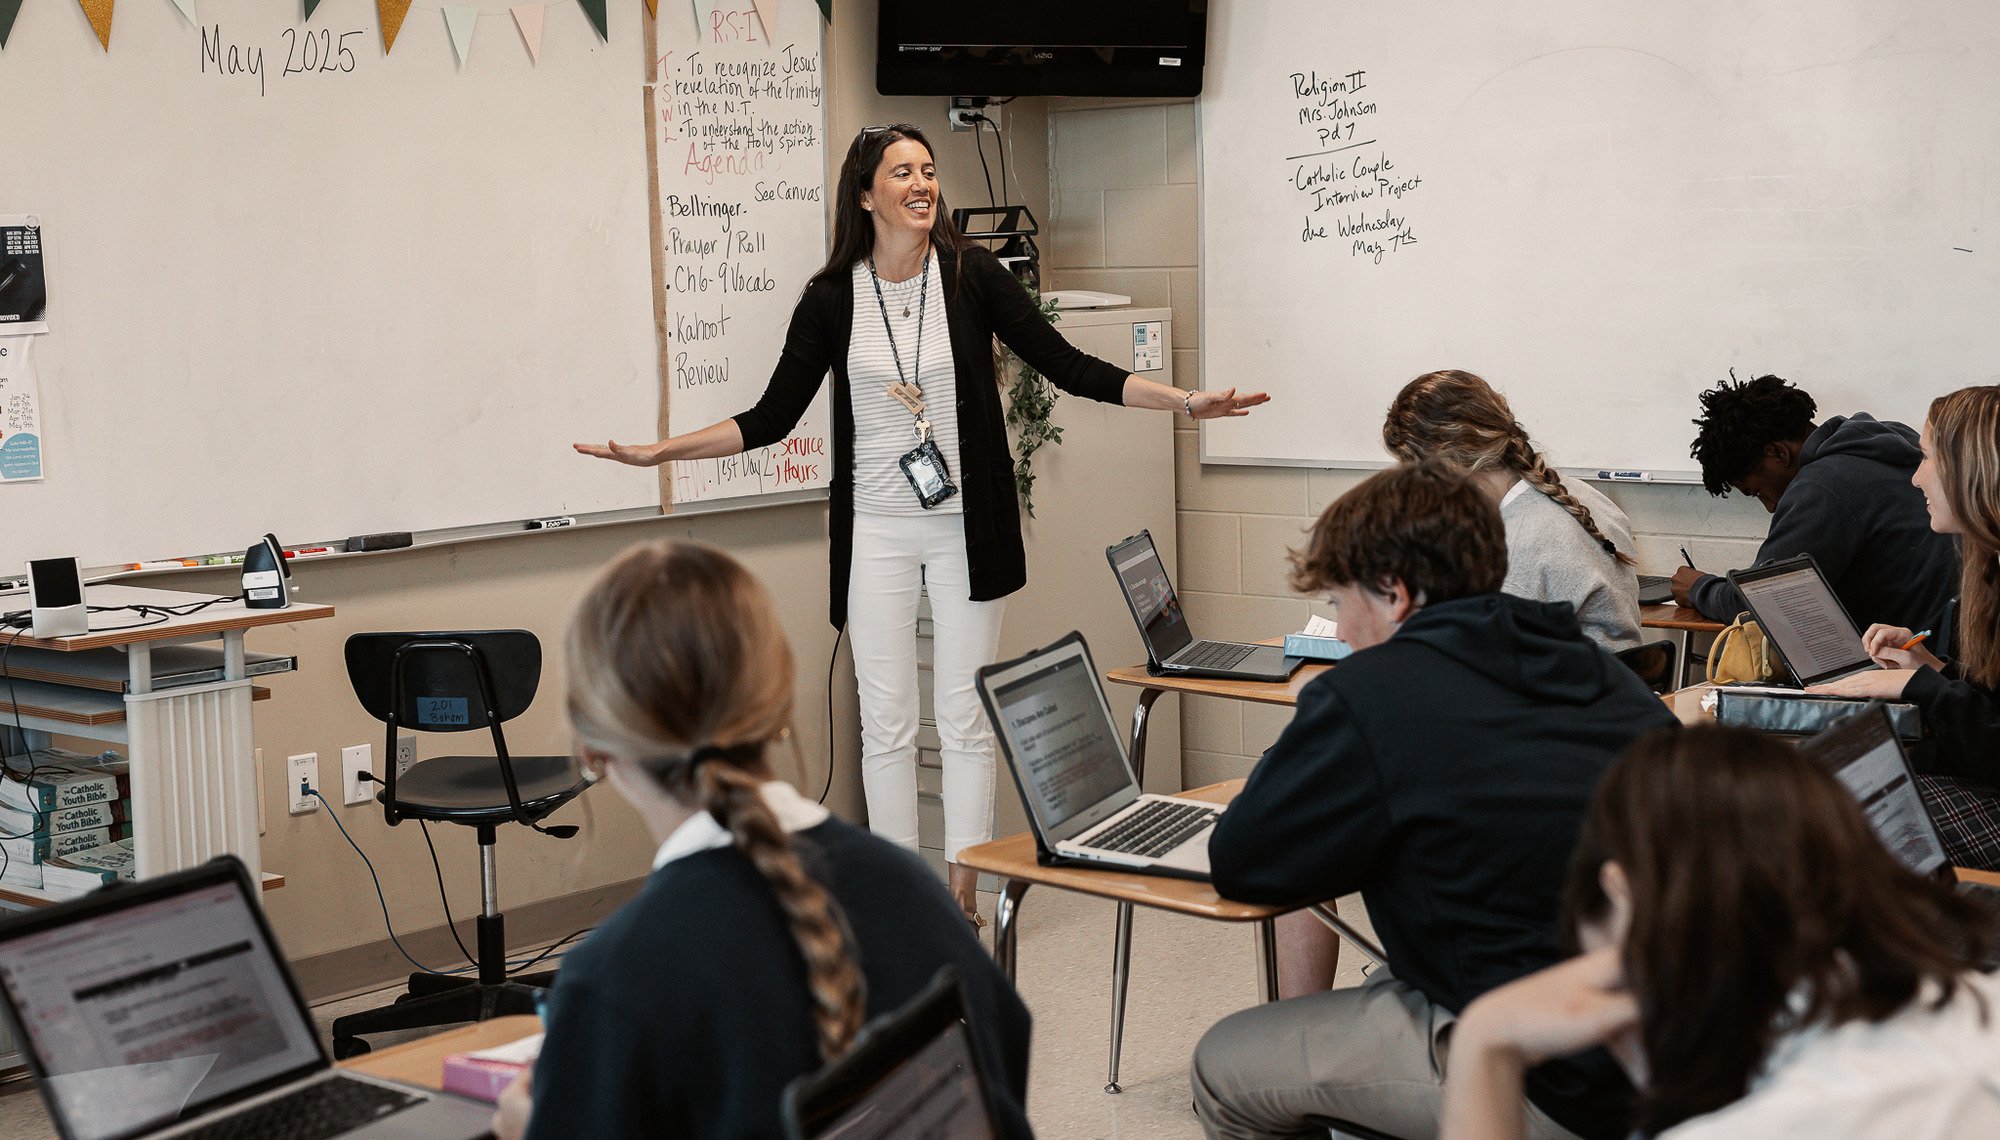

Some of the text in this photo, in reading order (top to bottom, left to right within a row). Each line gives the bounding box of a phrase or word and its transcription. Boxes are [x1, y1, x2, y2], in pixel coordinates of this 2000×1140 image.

[202, 24, 363, 97] May 2025
[687, 52, 703, 77] To
[715, 59, 776, 84] recognize
[675, 75, 821, 107] revelation of the Trinity
[1290, 70, 1367, 107] Religion II
[678, 101, 692, 116] in
[694, 97, 718, 116] the
[1299, 99, 1377, 124] Mrs. Johnson
[682, 117, 813, 138] To understand the action
[1345, 122, 1355, 140] 7
[703, 136, 716, 151] of
[721, 136, 740, 150] the
[747, 136, 774, 154] Holy
[685, 142, 766, 185] Agenda
[1353, 151, 1394, 181] Couple
[755, 180, 821, 202] See Canvas
[1311, 175, 1422, 212] Interview Project
[1302, 209, 1405, 242] due Wednesday
[668, 227, 718, 259] Prayer
[736, 230, 765, 253] Roll
[1353, 227, 1417, 265] May 7th
[731, 262, 776, 293] Vocab
[676, 304, 731, 344] Kahoot
[675, 352, 730, 389] Review
[780, 435, 825, 456] Service
[741, 450, 764, 493] Day
[431, 700, 453, 711] 201
[62, 791, 107, 806] Youth Bible
[70, 782, 104, 796] Catholic
[56, 817, 102, 832] Youth Bible
[64, 808, 98, 821] Catholic
[56, 845, 79, 858] Youth
[64, 833, 98, 847] Catholic
